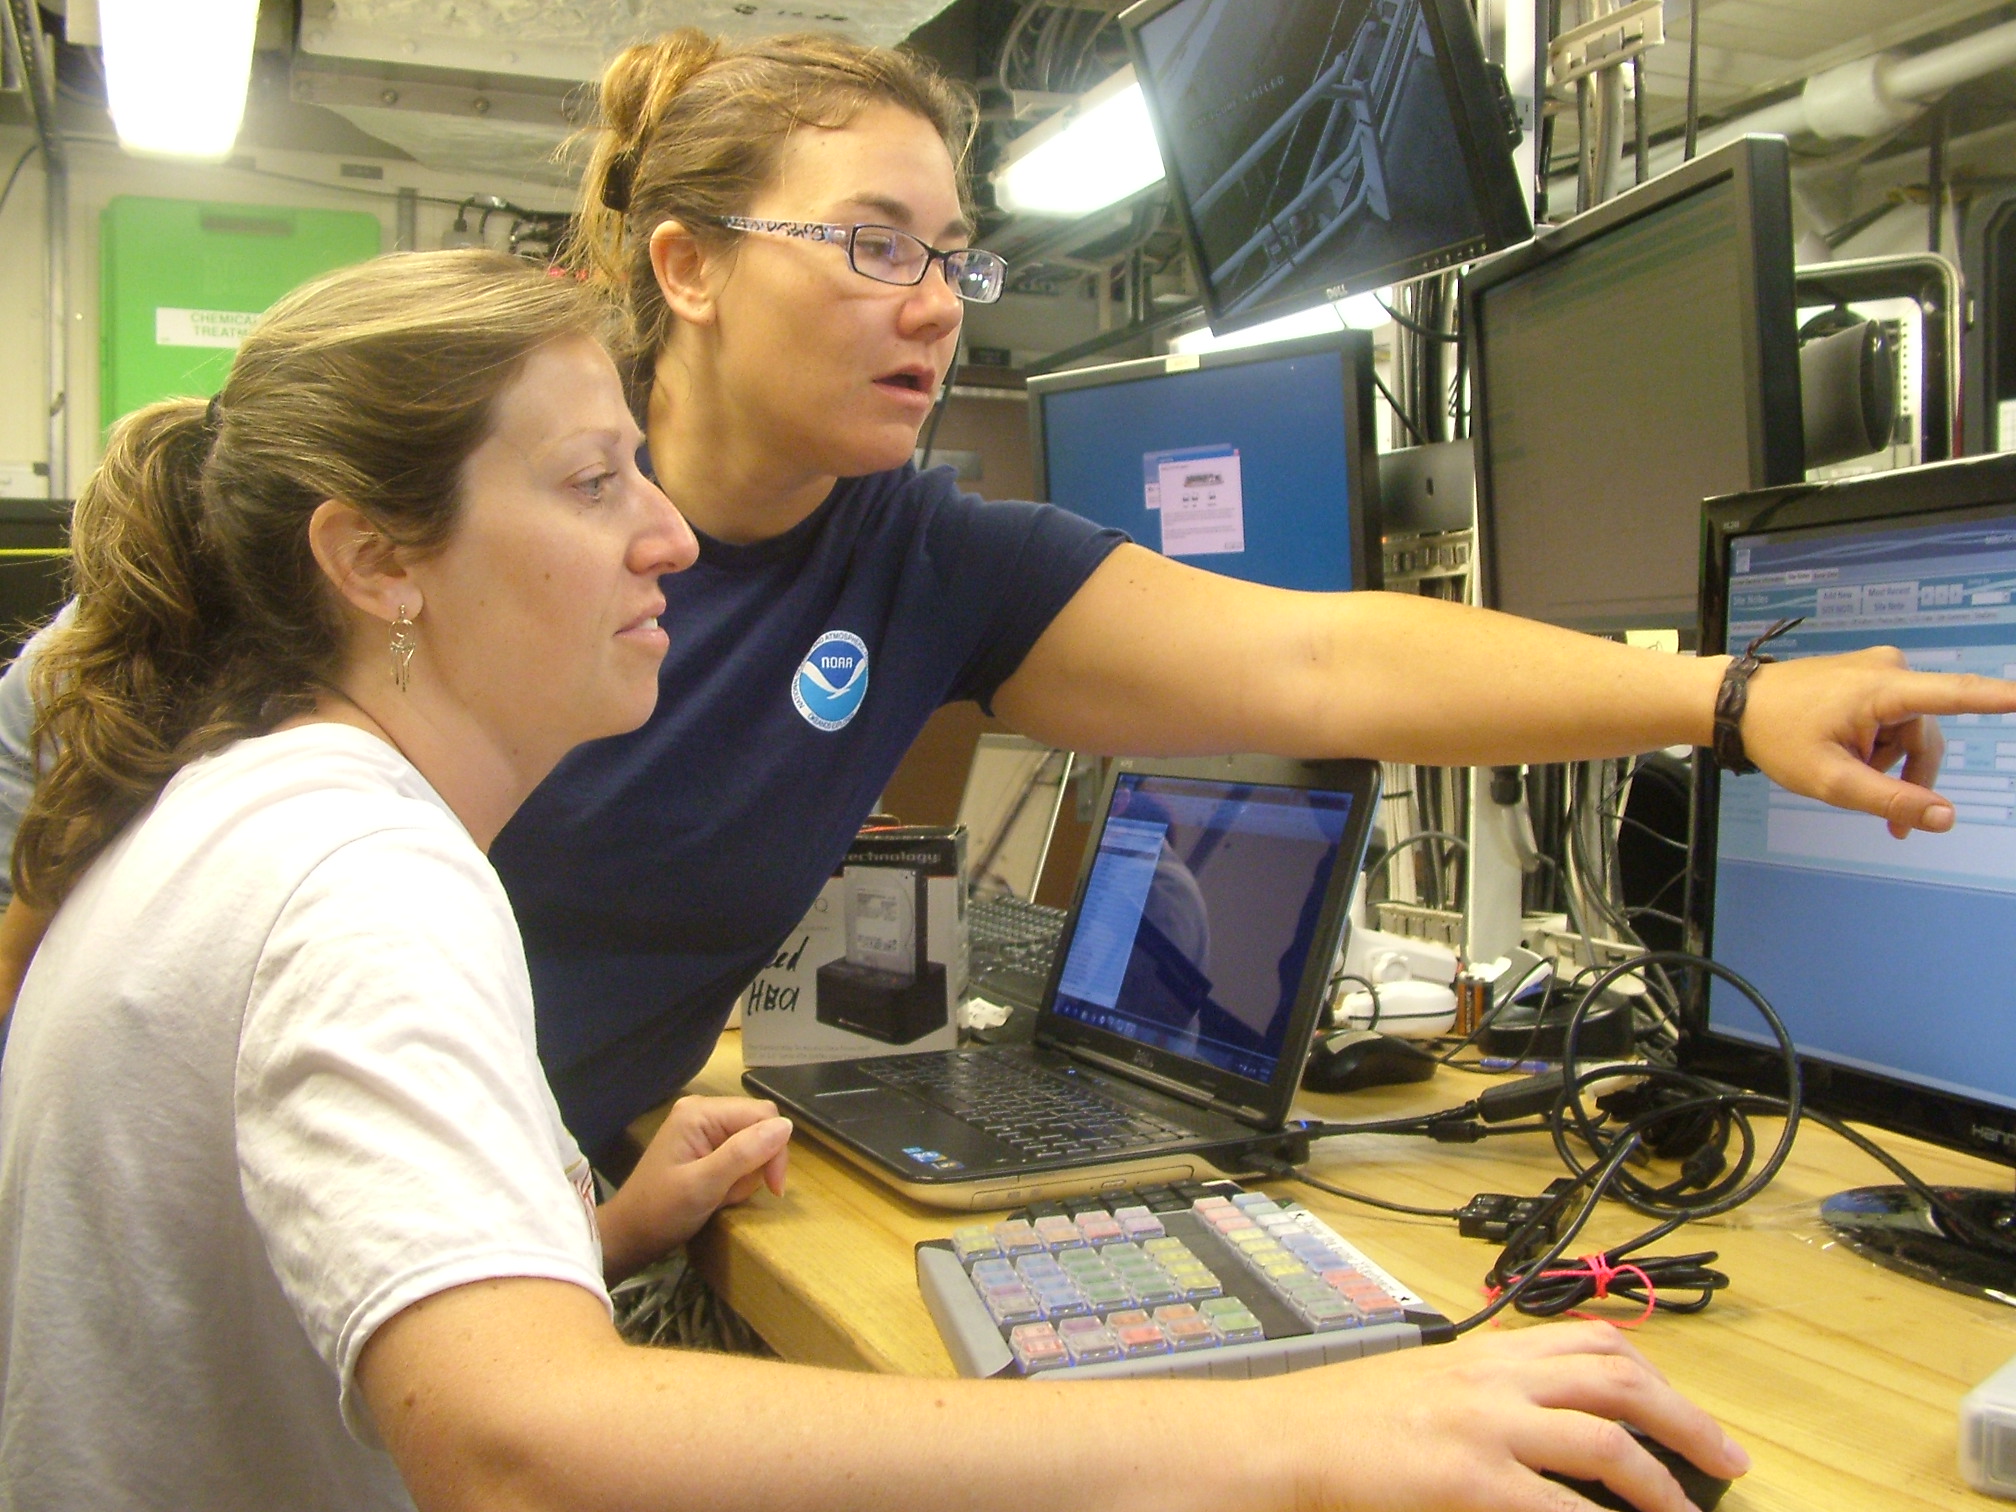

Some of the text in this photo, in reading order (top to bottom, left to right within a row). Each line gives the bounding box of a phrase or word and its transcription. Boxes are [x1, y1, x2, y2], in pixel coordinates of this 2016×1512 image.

[194, 325, 248, 337] TREATM
[821, 656, 853, 669] NOAA
[765, 936, 809, 972] ed
